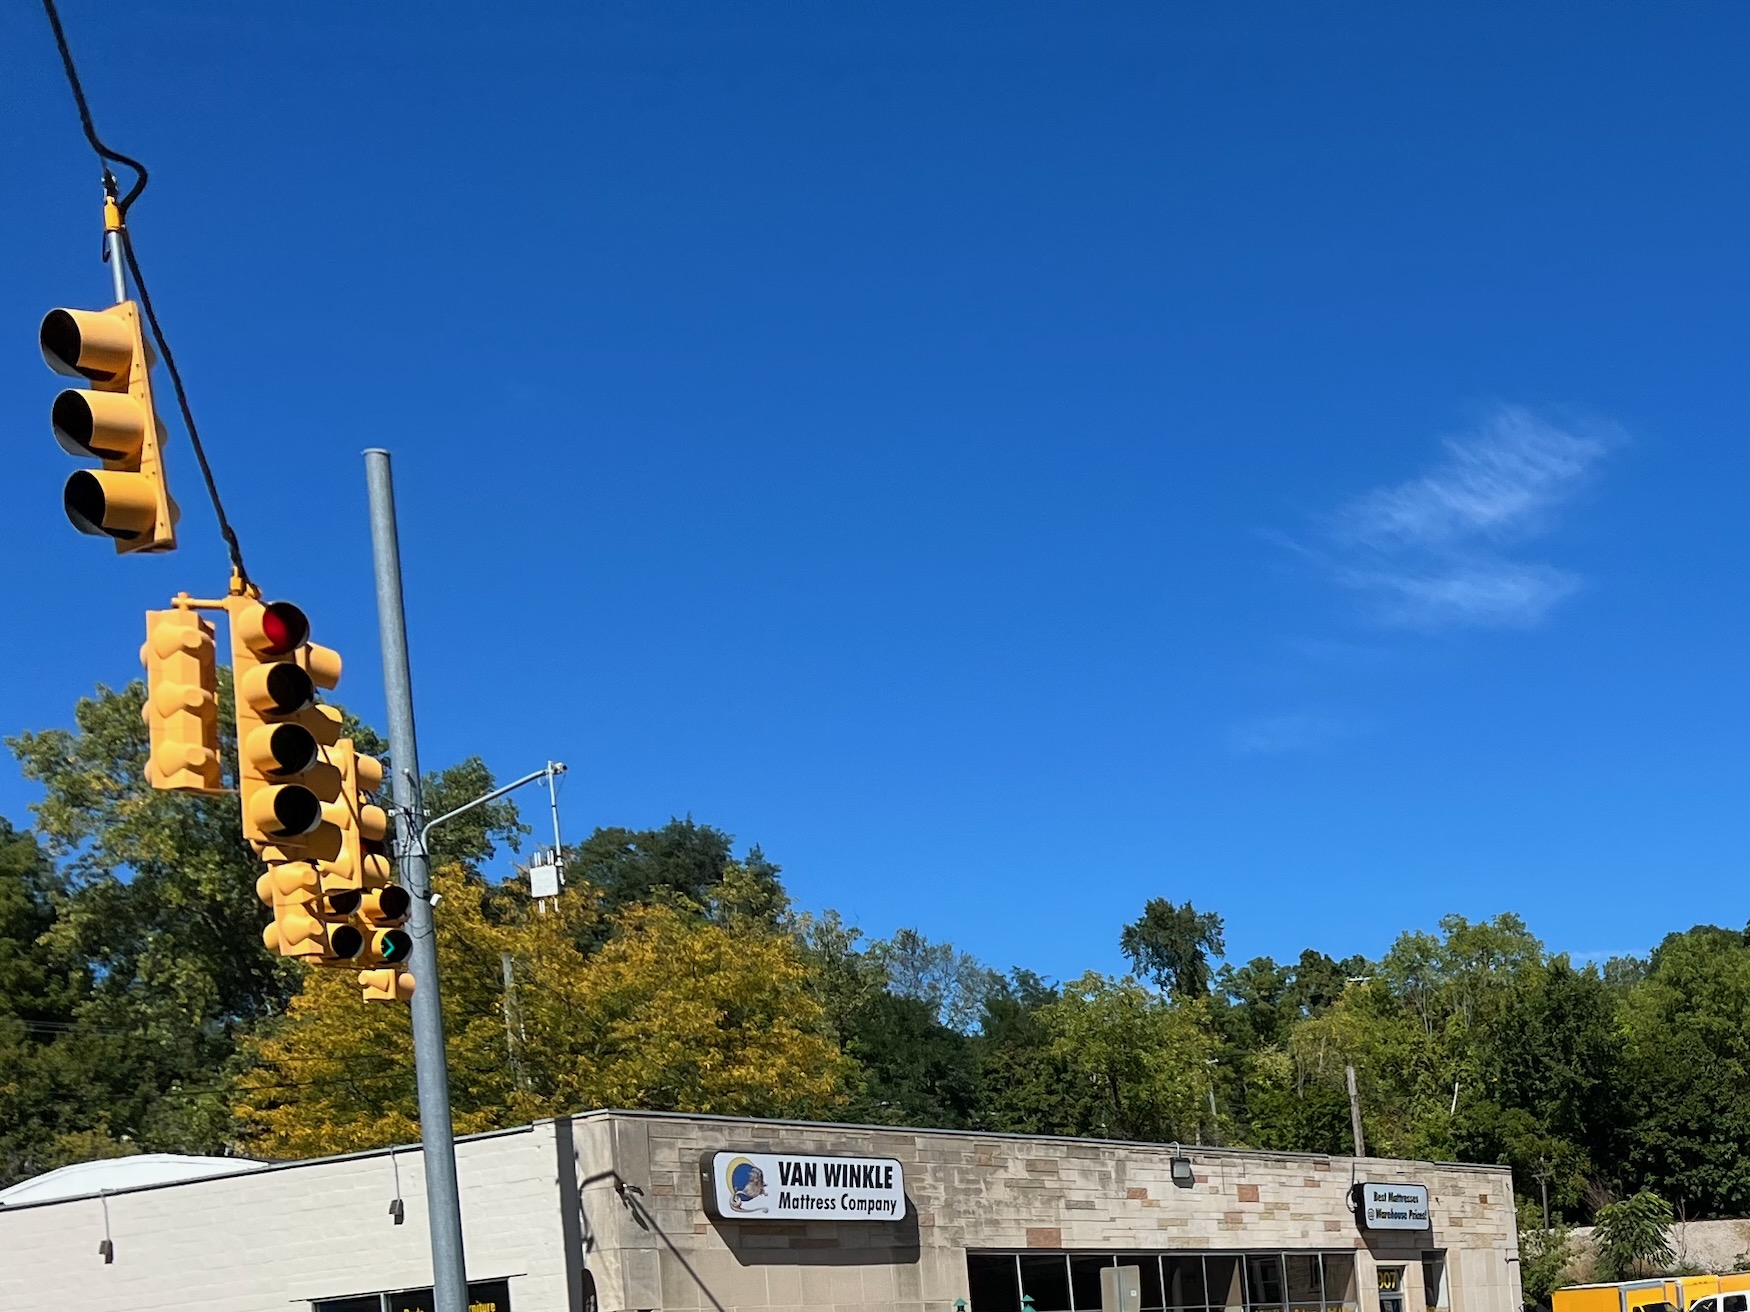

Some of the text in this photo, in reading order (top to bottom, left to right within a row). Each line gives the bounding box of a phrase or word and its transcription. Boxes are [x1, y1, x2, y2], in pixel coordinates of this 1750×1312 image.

[778, 1161, 893, 1189] VAN WINKLE
[778, 1192, 897, 1215] Mattress Company
[1373, 1191, 1419, 1204] Best Mattresses
[1375, 1208, 1408, 1220] Warehouse
